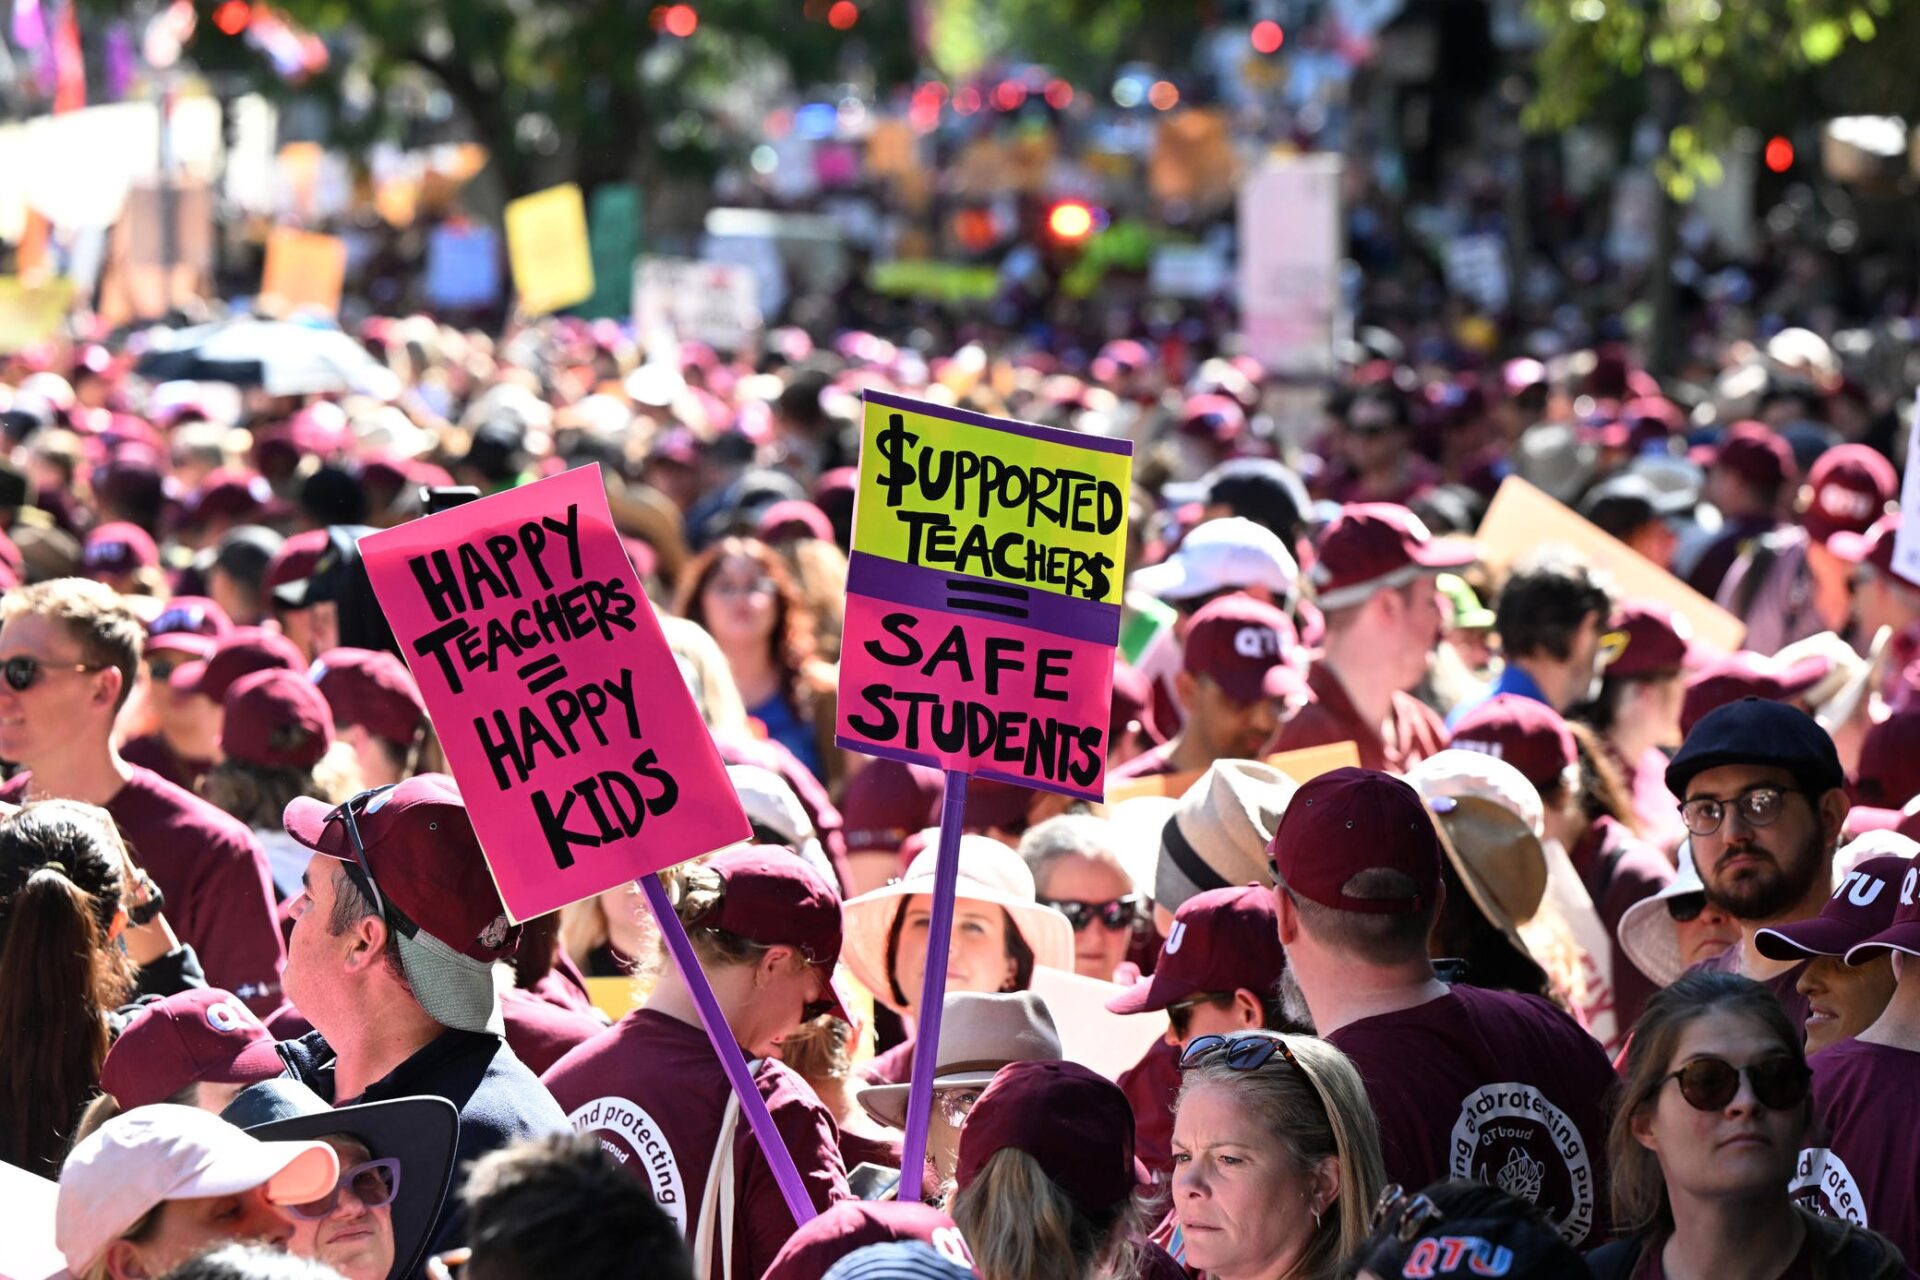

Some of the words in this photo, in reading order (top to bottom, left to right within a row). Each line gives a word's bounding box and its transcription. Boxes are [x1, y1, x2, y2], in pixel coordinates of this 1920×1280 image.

[408, 503, 584, 622] HAPPY
[946, 579, 1029, 618] =
[413, 577, 637, 695] TEACHERS
[517, 654, 568, 695] =
[863, 612, 1073, 702] SAFE
[1234, 626, 1284, 659] QT
[474, 667, 642, 791] HAPPY
[847, 684, 1103, 787] STUDENTS
[531, 748, 679, 870] KIDS
[1832, 871, 1886, 907] TU
[601, 1139, 630, 1164] proud
[603, 1105, 677, 1205] protecting
[1822, 1162, 1864, 1226] rotec
[1402, 1235, 1514, 1279] QTU
